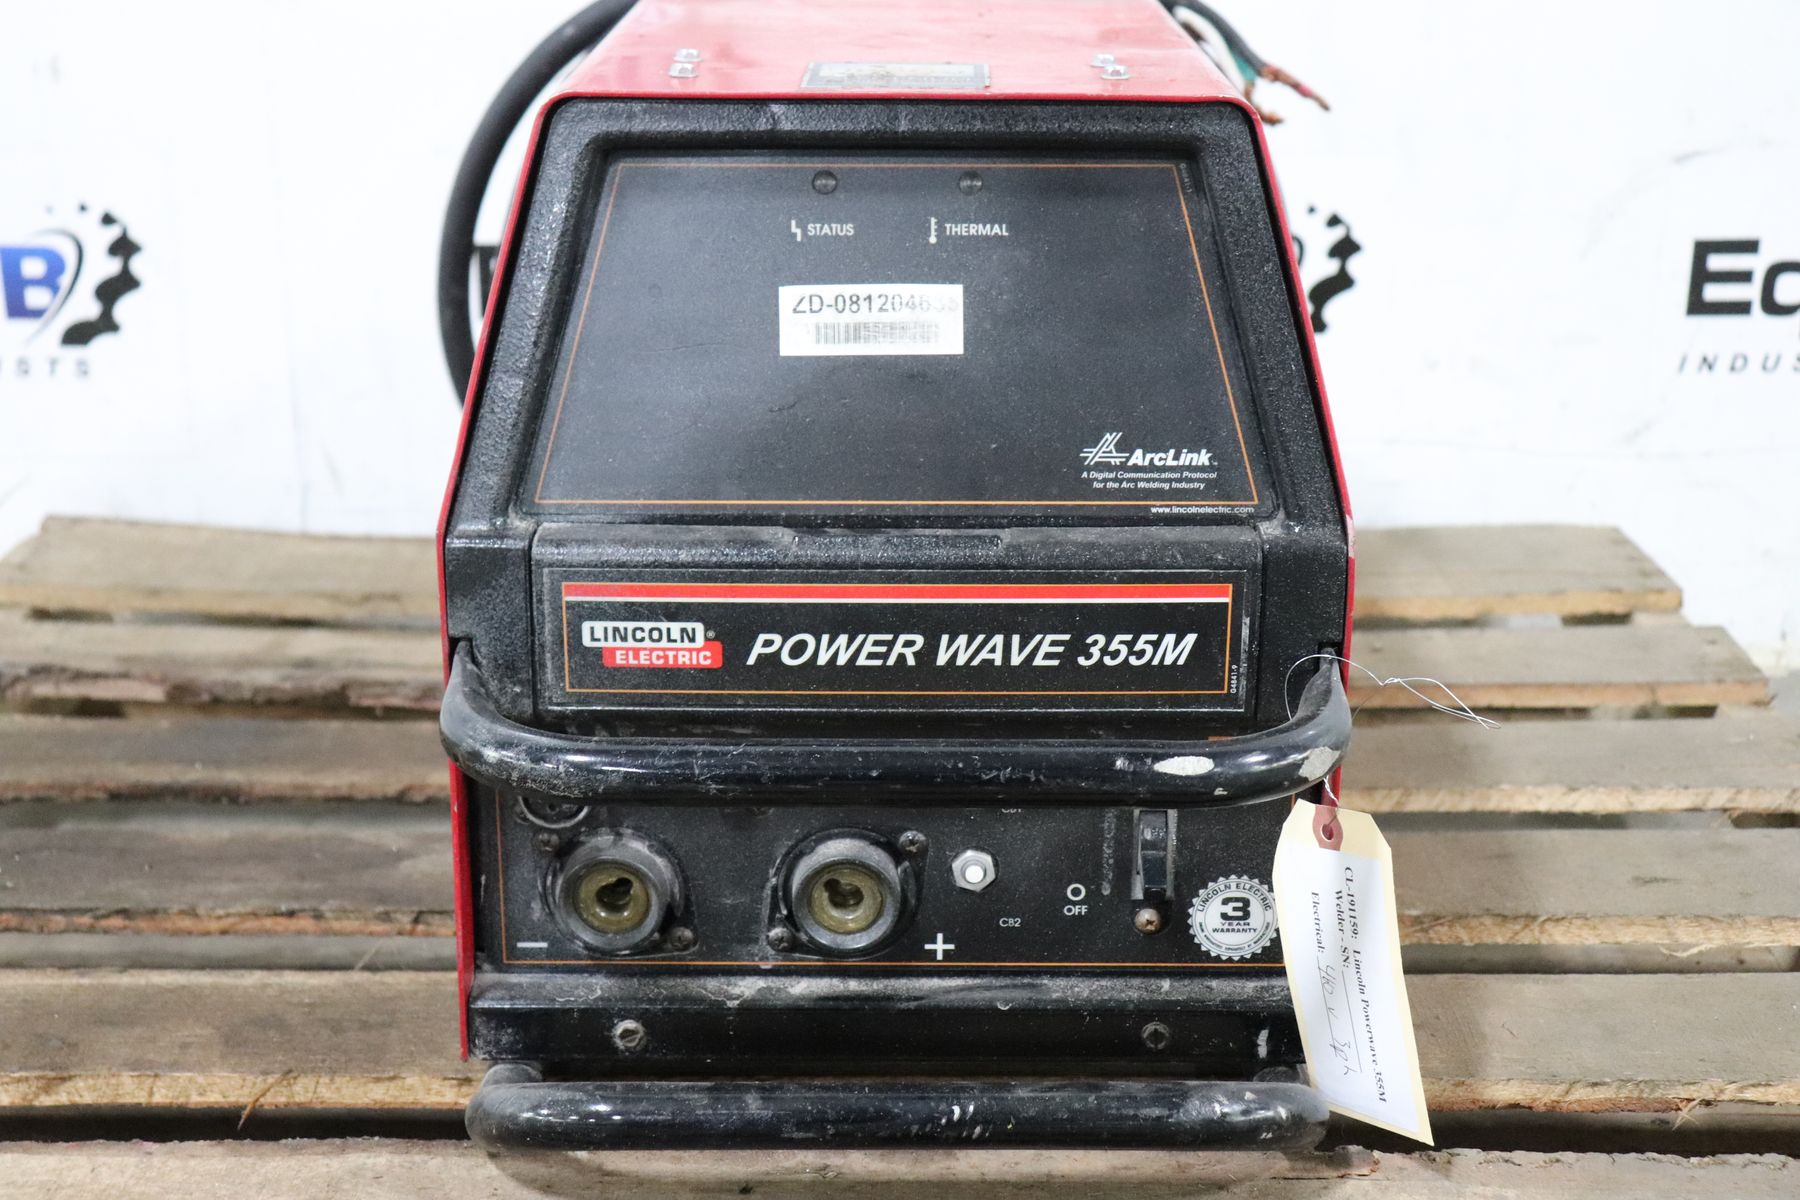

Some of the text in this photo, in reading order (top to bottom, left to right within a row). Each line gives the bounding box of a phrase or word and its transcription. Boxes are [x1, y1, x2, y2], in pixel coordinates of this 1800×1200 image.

[807, 223, 854, 236] STATUS
[945, 223, 1009, 236] THERMAL
[1127, 449, 1212, 466] ArcLink
[1090, 471, 1116, 480] Digital
[1117, 471, 1181, 479] Communication
[1183, 471, 1217, 479] Protocol
[1093, 481, 1205, 490] for the Arc Welding Industry
[1150, 505, 1254, 514] www.lincolnelectric.com
[589, 626, 696, 643] LINCOLN
[615, 649, 712, 665] ELECTRIC
[746, 633, 1198, 666] POWER WAVE 355M
[1197, 882, 1272, 912] LINCOLN ELECTRIC
[1064, 905, 1088, 916] OFF
[1220, 896, 1251, 922] 3
[999, 917, 1021, 927] CB2
[1311, 891, 1325, 953] Electrical:
[1335, 890, 1345, 935] Welder
[1340, 945, 1350, 968] SN:
[1344, 866, 1387, 1103] CL-191159: Lincoln Powerwave 355M
